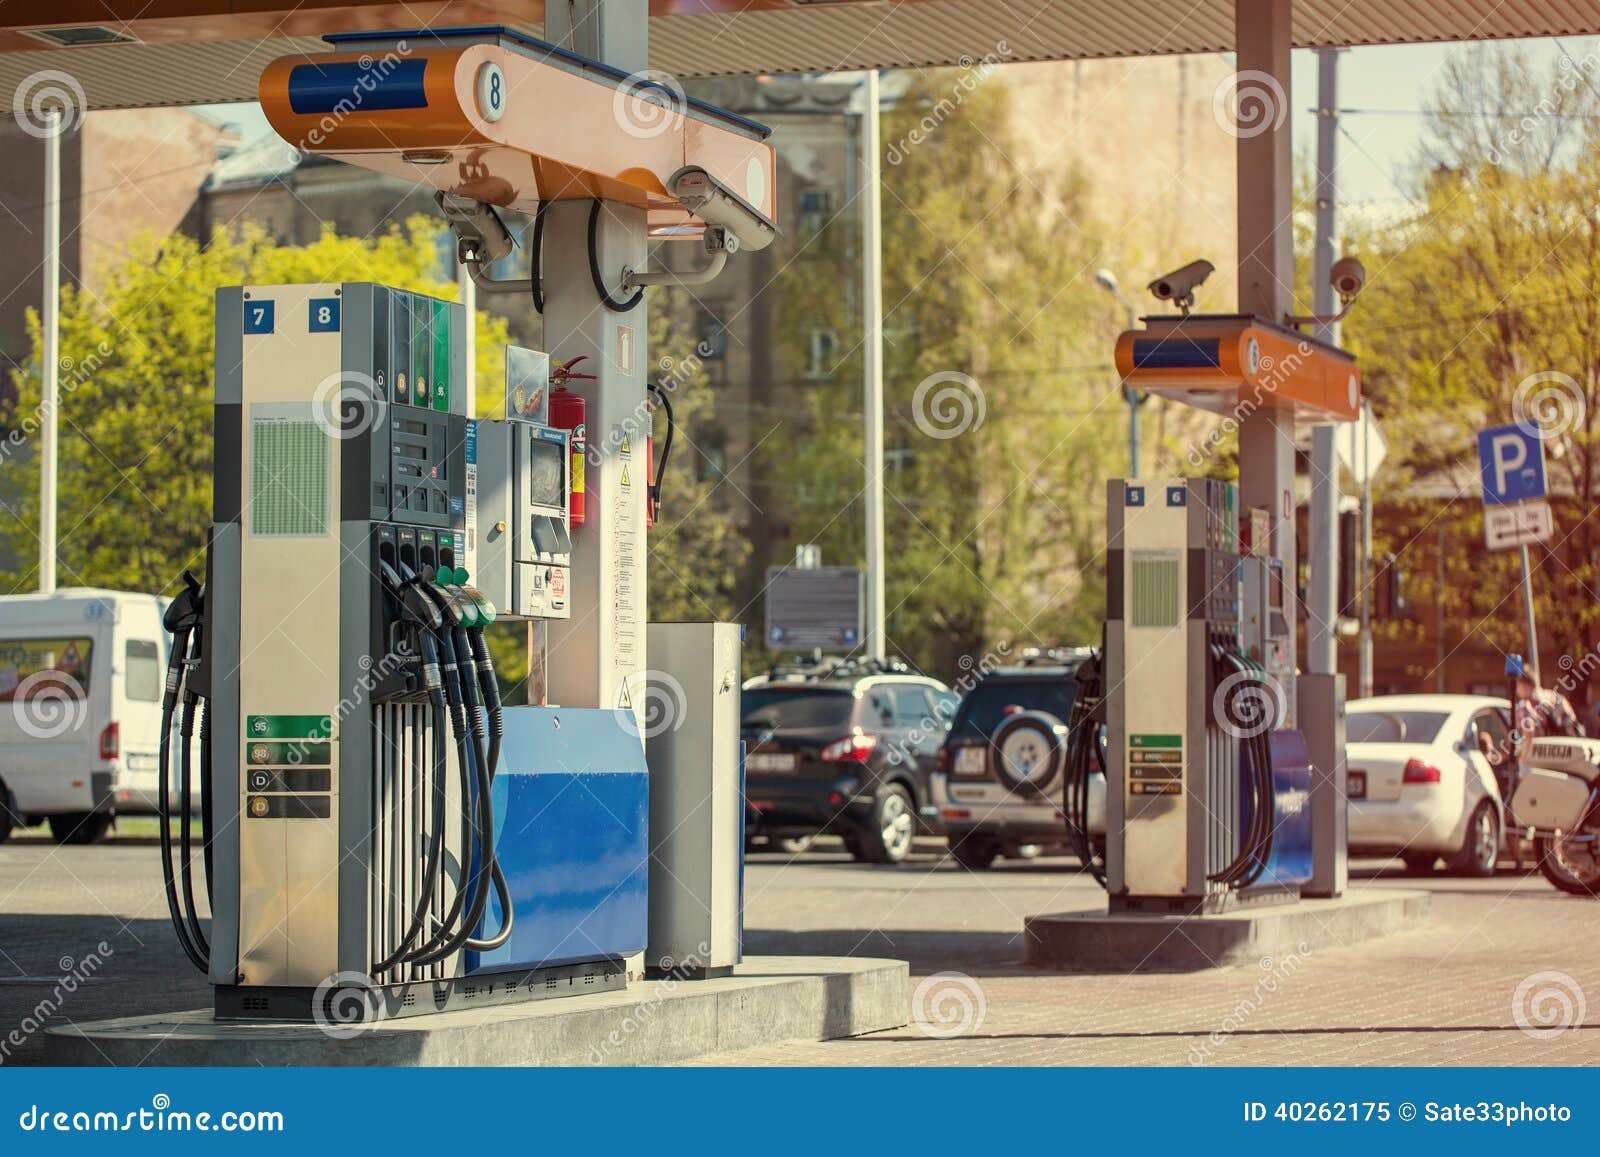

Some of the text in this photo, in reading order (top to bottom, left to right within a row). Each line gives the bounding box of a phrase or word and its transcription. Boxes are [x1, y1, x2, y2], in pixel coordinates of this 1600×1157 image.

[491, 72, 500, 110] 8
[253, 306, 331, 326] 7 8
[1492, 434, 1527, 495] P
[1131, 490, 1181, 503] 5 6
[254, 721, 267, 732] 95
[256, 776, 265, 786] D
[255, 803, 265, 812] D
